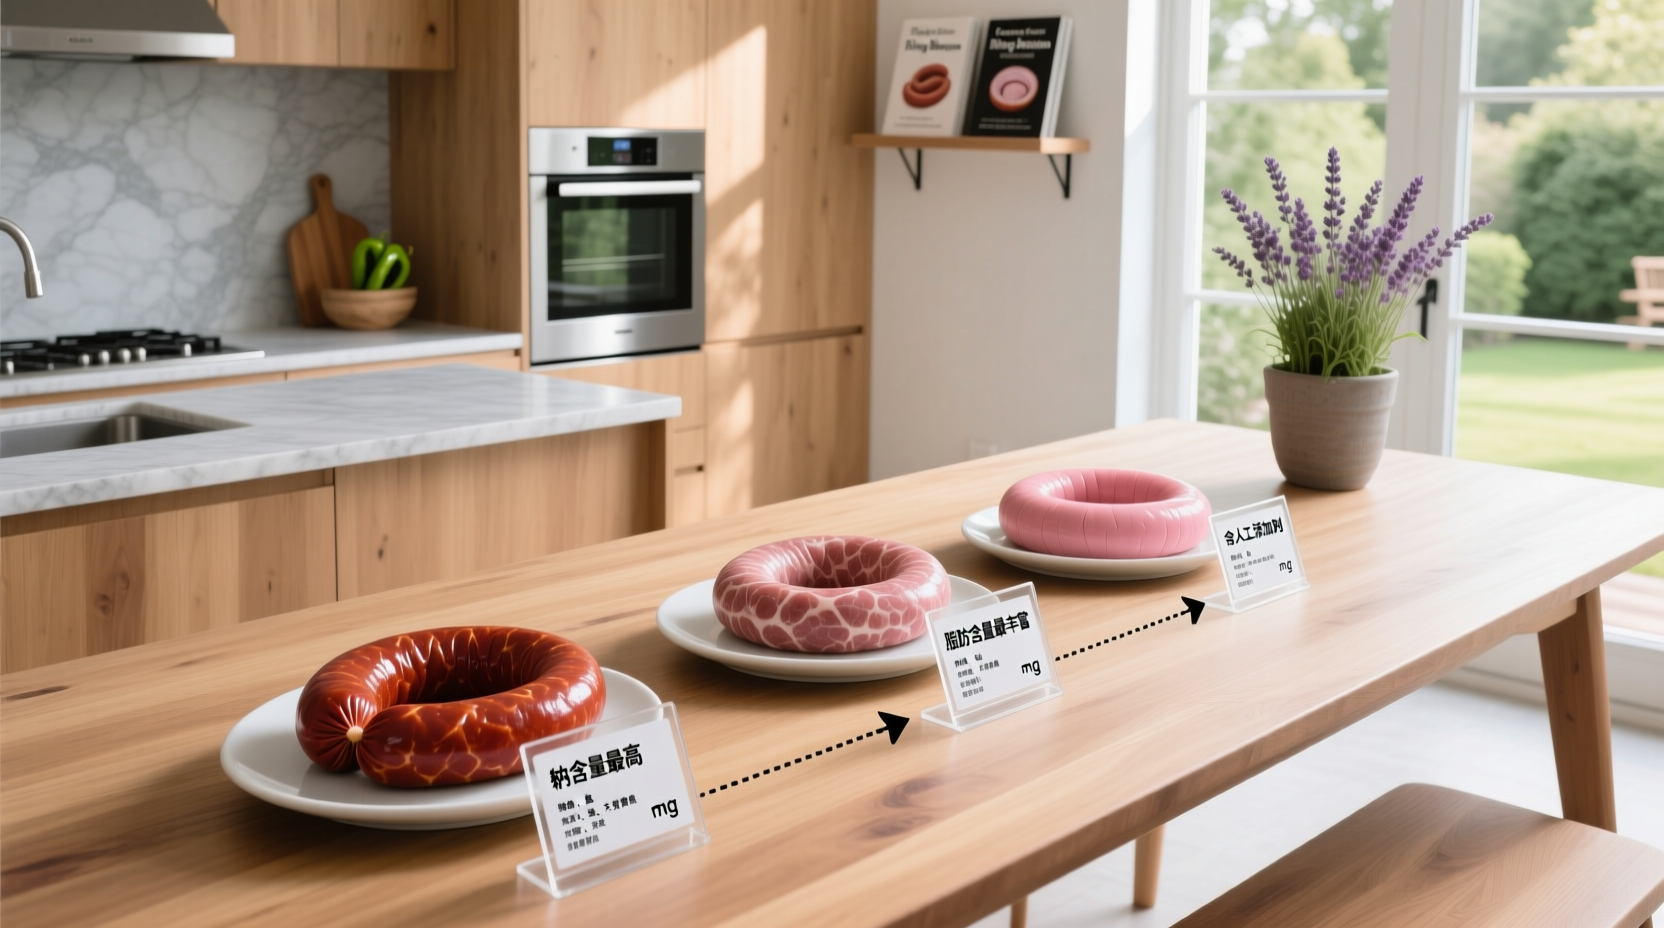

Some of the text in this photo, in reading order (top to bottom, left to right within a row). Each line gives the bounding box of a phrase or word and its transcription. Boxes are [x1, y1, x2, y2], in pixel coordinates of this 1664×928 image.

[1279, 560, 1293, 574] mg
[1021, 660, 1042, 676] mg
[651, 798, 679, 818] mg
